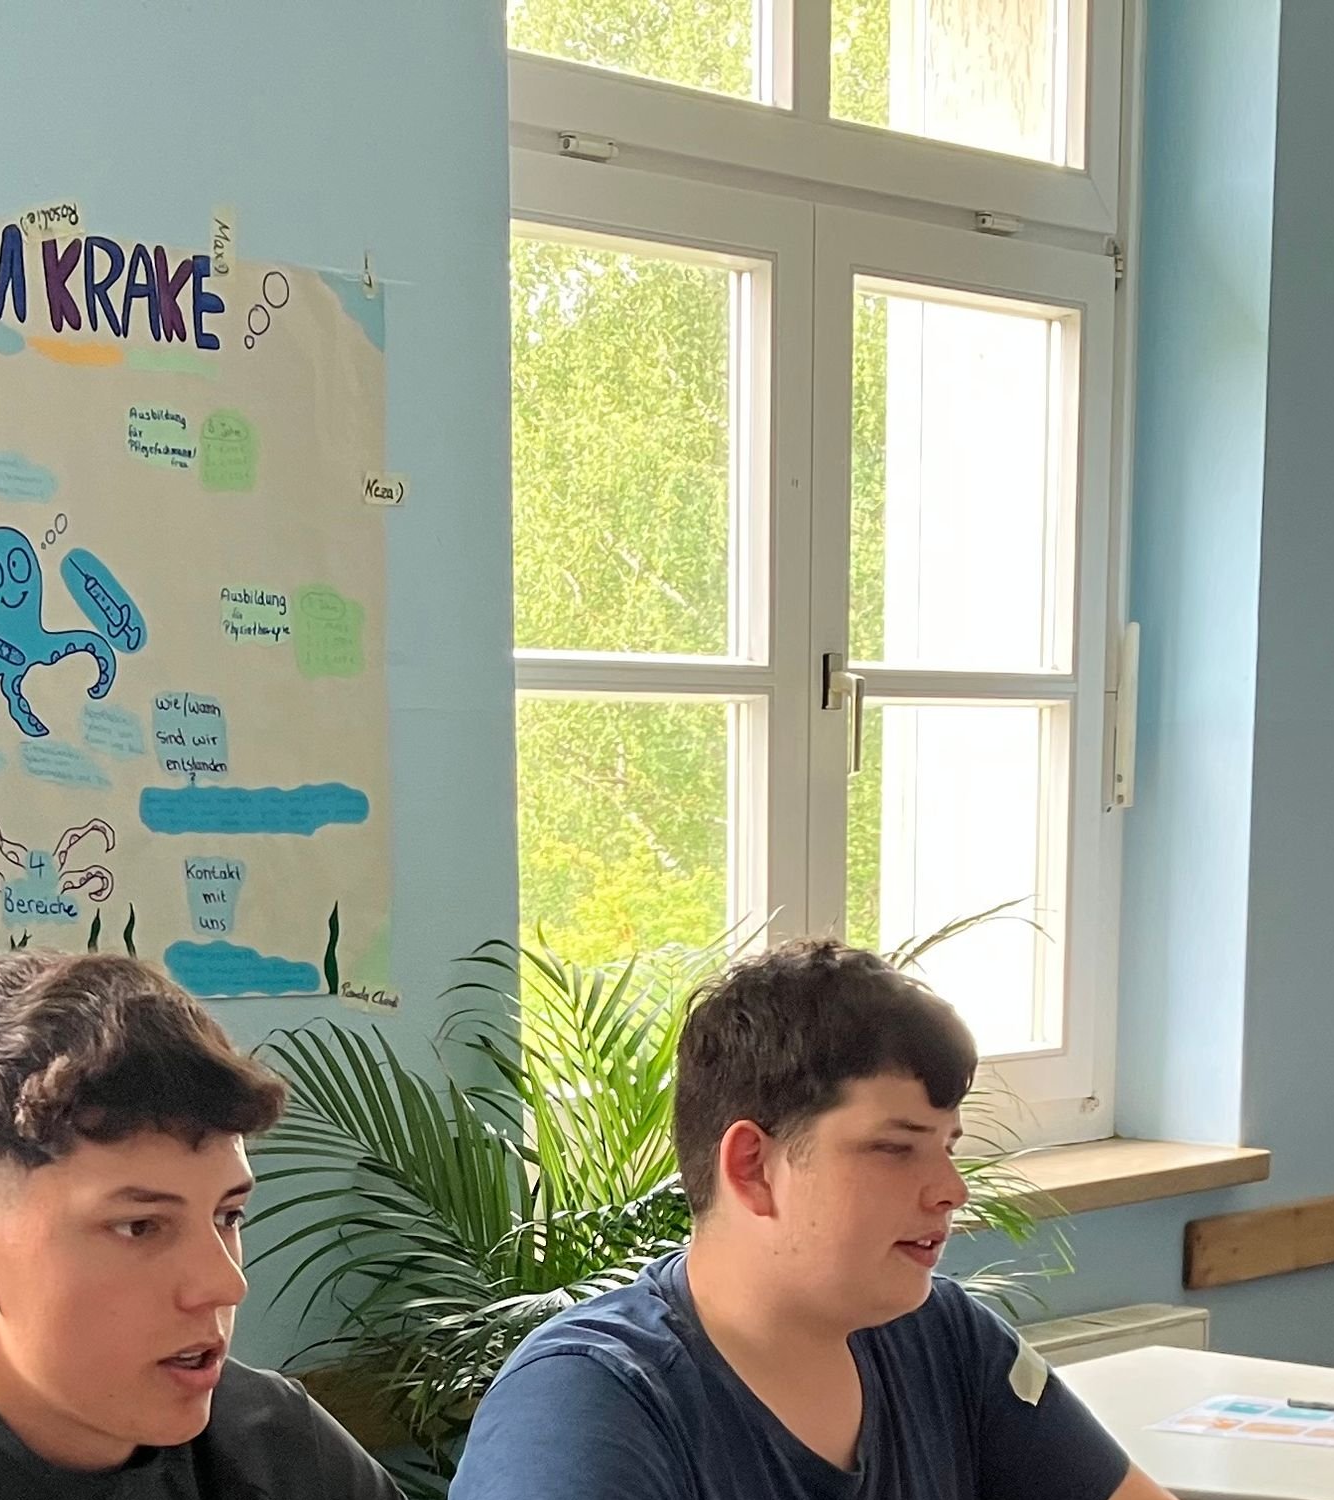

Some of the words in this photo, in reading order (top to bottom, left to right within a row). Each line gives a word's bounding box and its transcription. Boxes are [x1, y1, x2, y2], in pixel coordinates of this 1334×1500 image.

[42, 235, 225, 350] KRAKE
[129, 406, 186, 430] Ausbildung
[220, 587, 287, 616] Ausbildung
[192, 735, 219, 747] wir
[166, 756, 228, 773] entstanden
[29, 850, 45, 879] 4
[4, 886, 78, 917] Bereiche
[202, 887, 227, 905] mit
